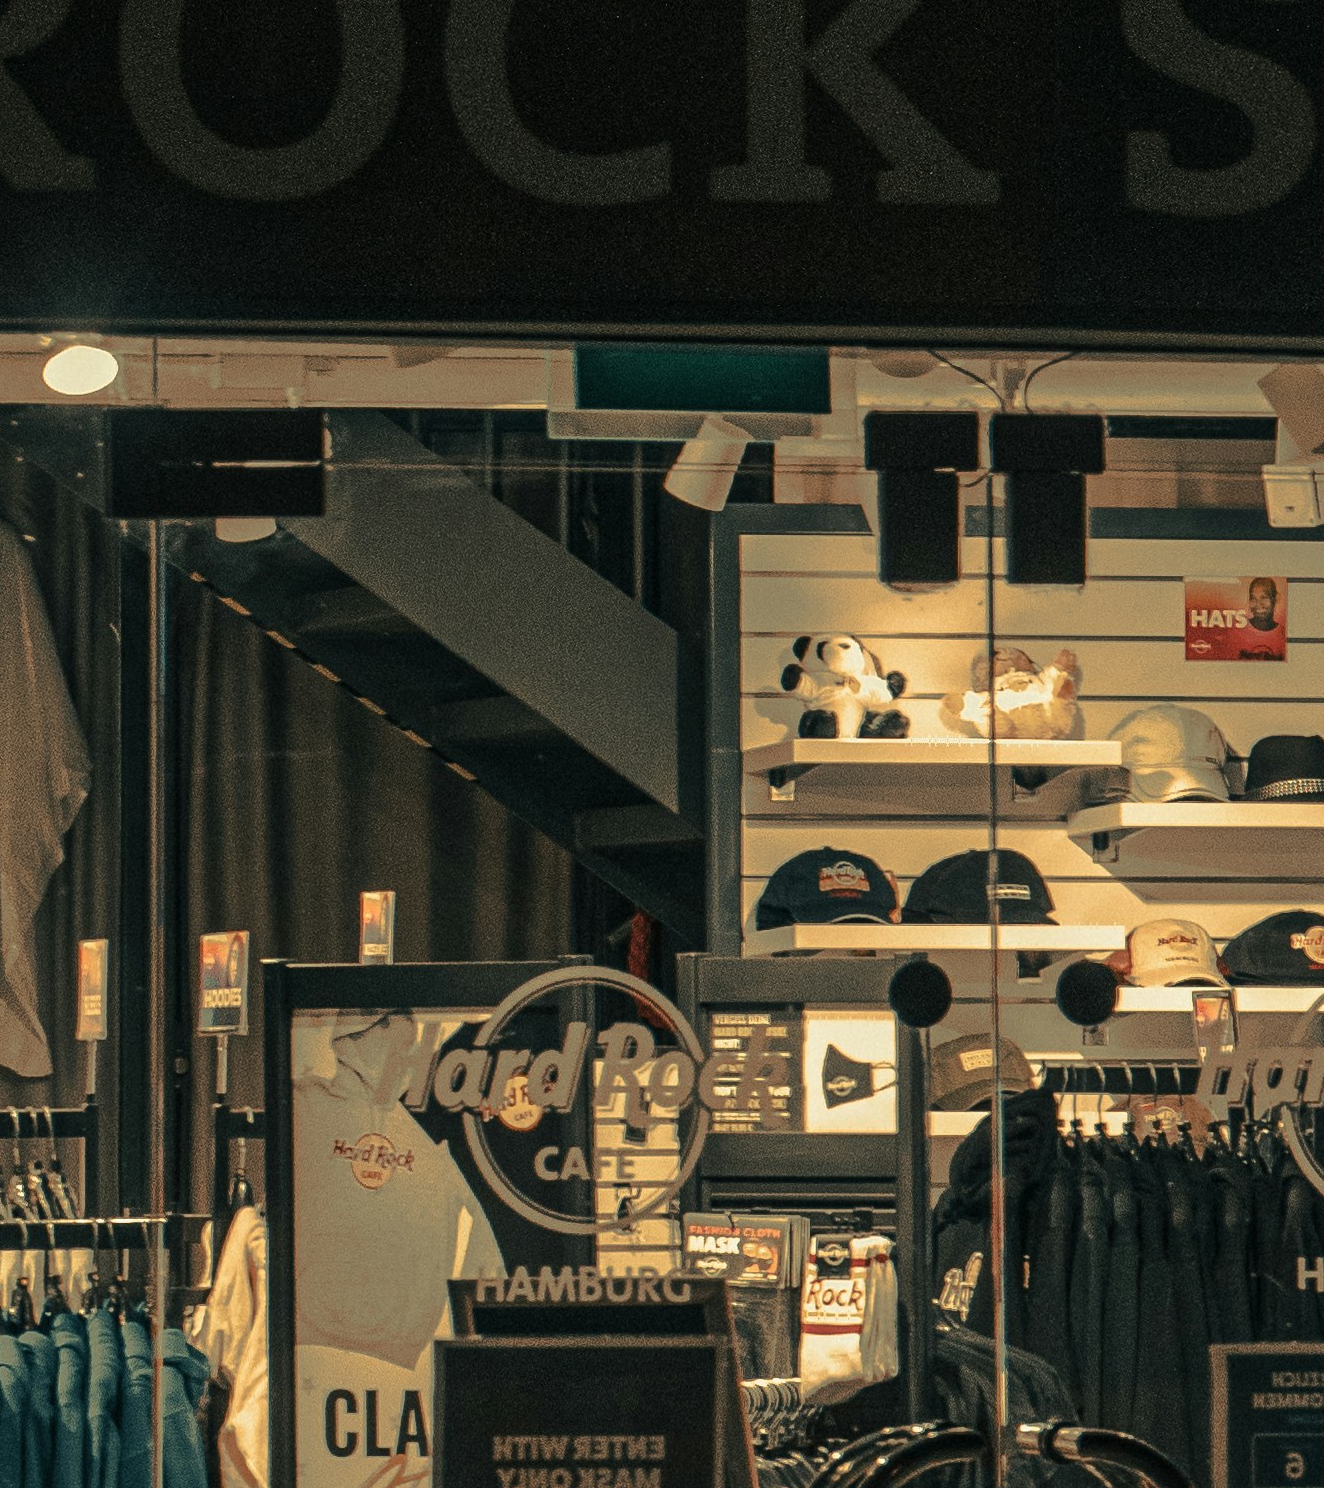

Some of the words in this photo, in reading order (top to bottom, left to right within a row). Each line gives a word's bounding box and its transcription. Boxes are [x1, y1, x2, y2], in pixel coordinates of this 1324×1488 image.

[1190, 609, 1249, 629] HATS
[372, 1016, 592, 1113] Hard
[596, 1021, 791, 1131] Rock
[533, 1145, 637, 1182] CAFE
[687, 1235, 741, 1255] MASK
[475, 1265, 693, 1303] HAMBURG
[807, 1278, 864, 1312] Rock
[325, 1388, 431, 1457] CLA
